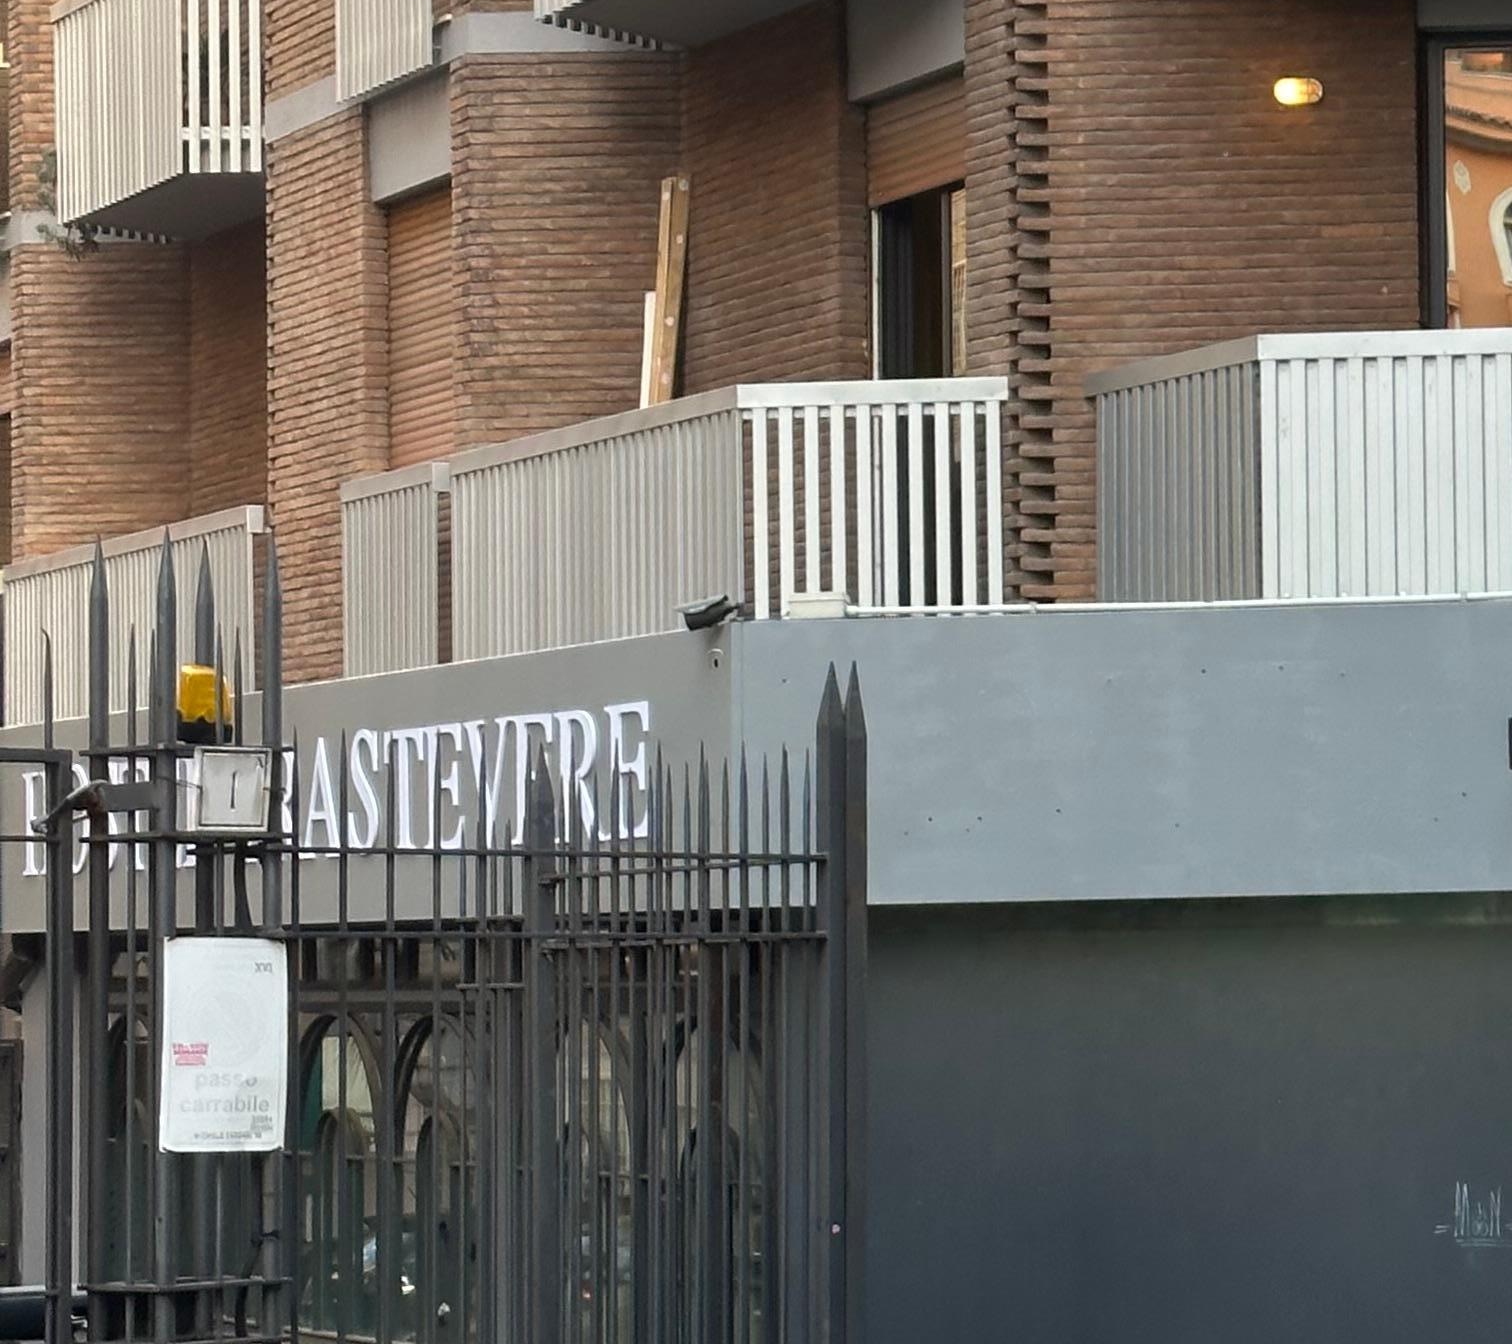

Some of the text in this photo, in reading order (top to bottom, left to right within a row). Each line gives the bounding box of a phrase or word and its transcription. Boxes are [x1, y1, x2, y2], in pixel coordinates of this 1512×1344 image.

[241, 700, 649, 863] RASTEVERE
[195, 1072, 258, 1090] passo
[180, 1094, 270, 1113] carrabile
